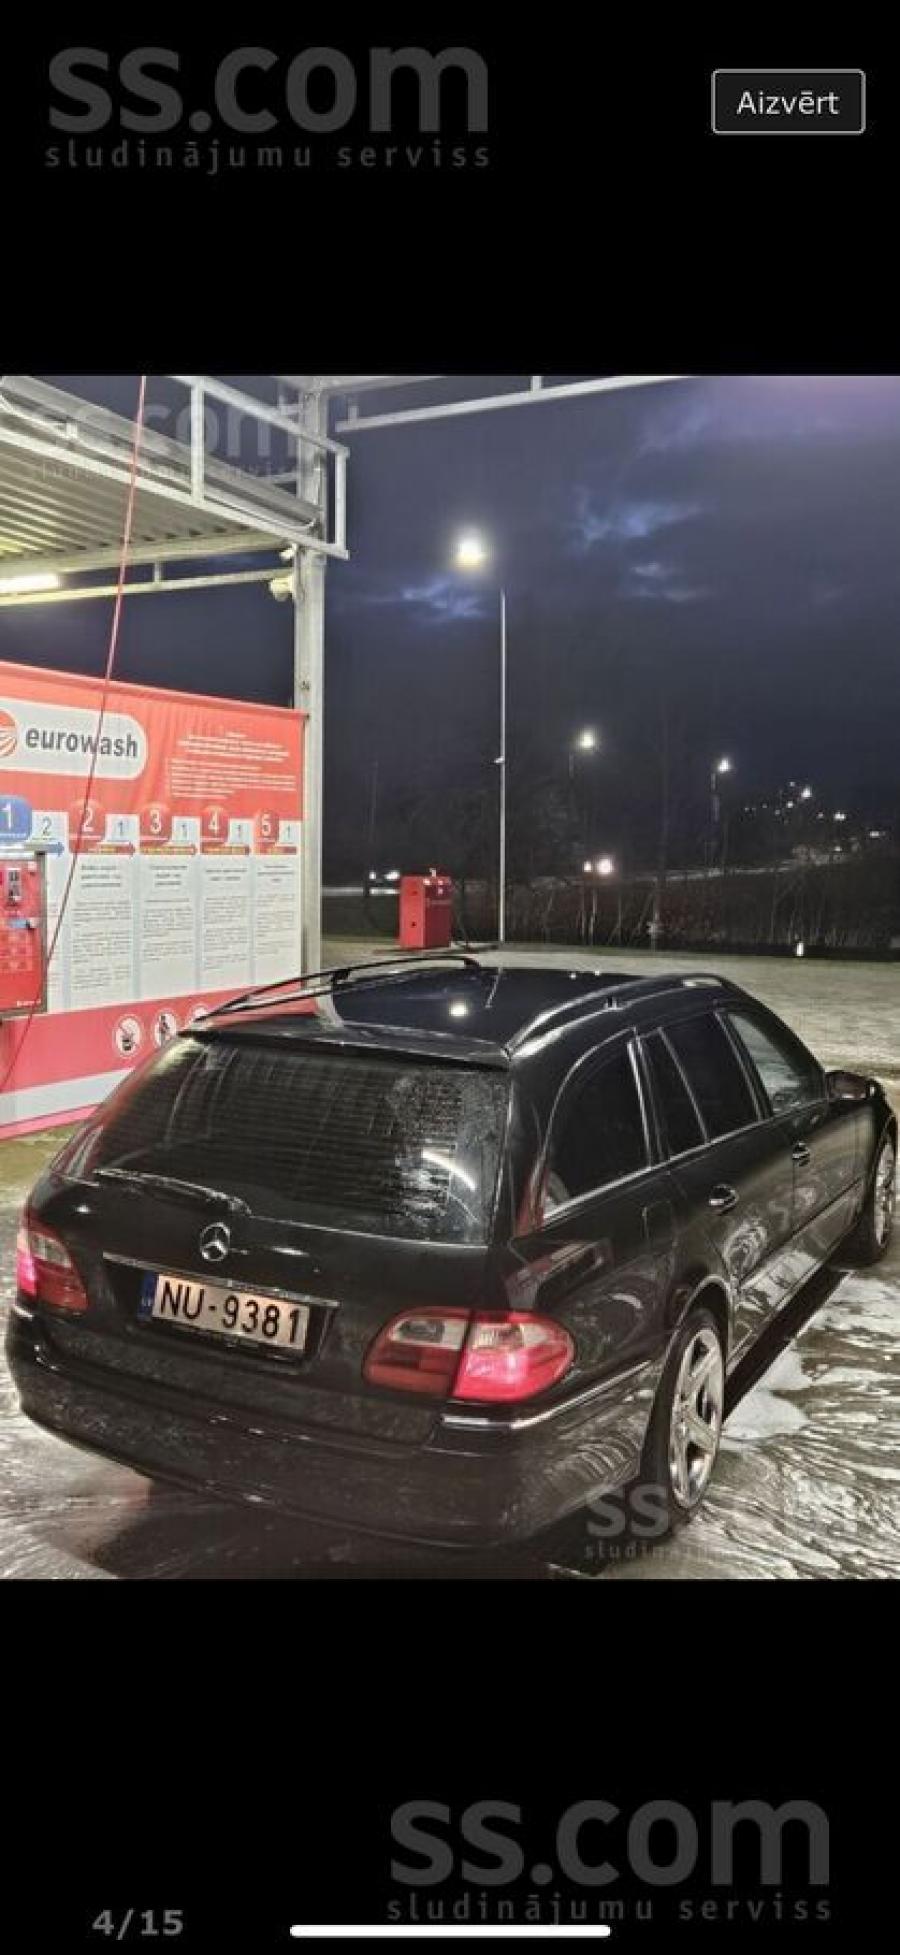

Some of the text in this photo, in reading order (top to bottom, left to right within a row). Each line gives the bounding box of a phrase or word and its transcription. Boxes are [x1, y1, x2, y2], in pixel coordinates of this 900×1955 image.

[26, 728, 138, 757] eurowash
[2, 802, 12, 830] 1
[42, 816, 52, 836] 2
[82, 807, 94, 833] 2
[150, 808, 161, 835] 3
[208, 811, 220, 837] 4
[261, 813, 271, 838] 5
[160, 1281, 300, 1344] NU-9381
